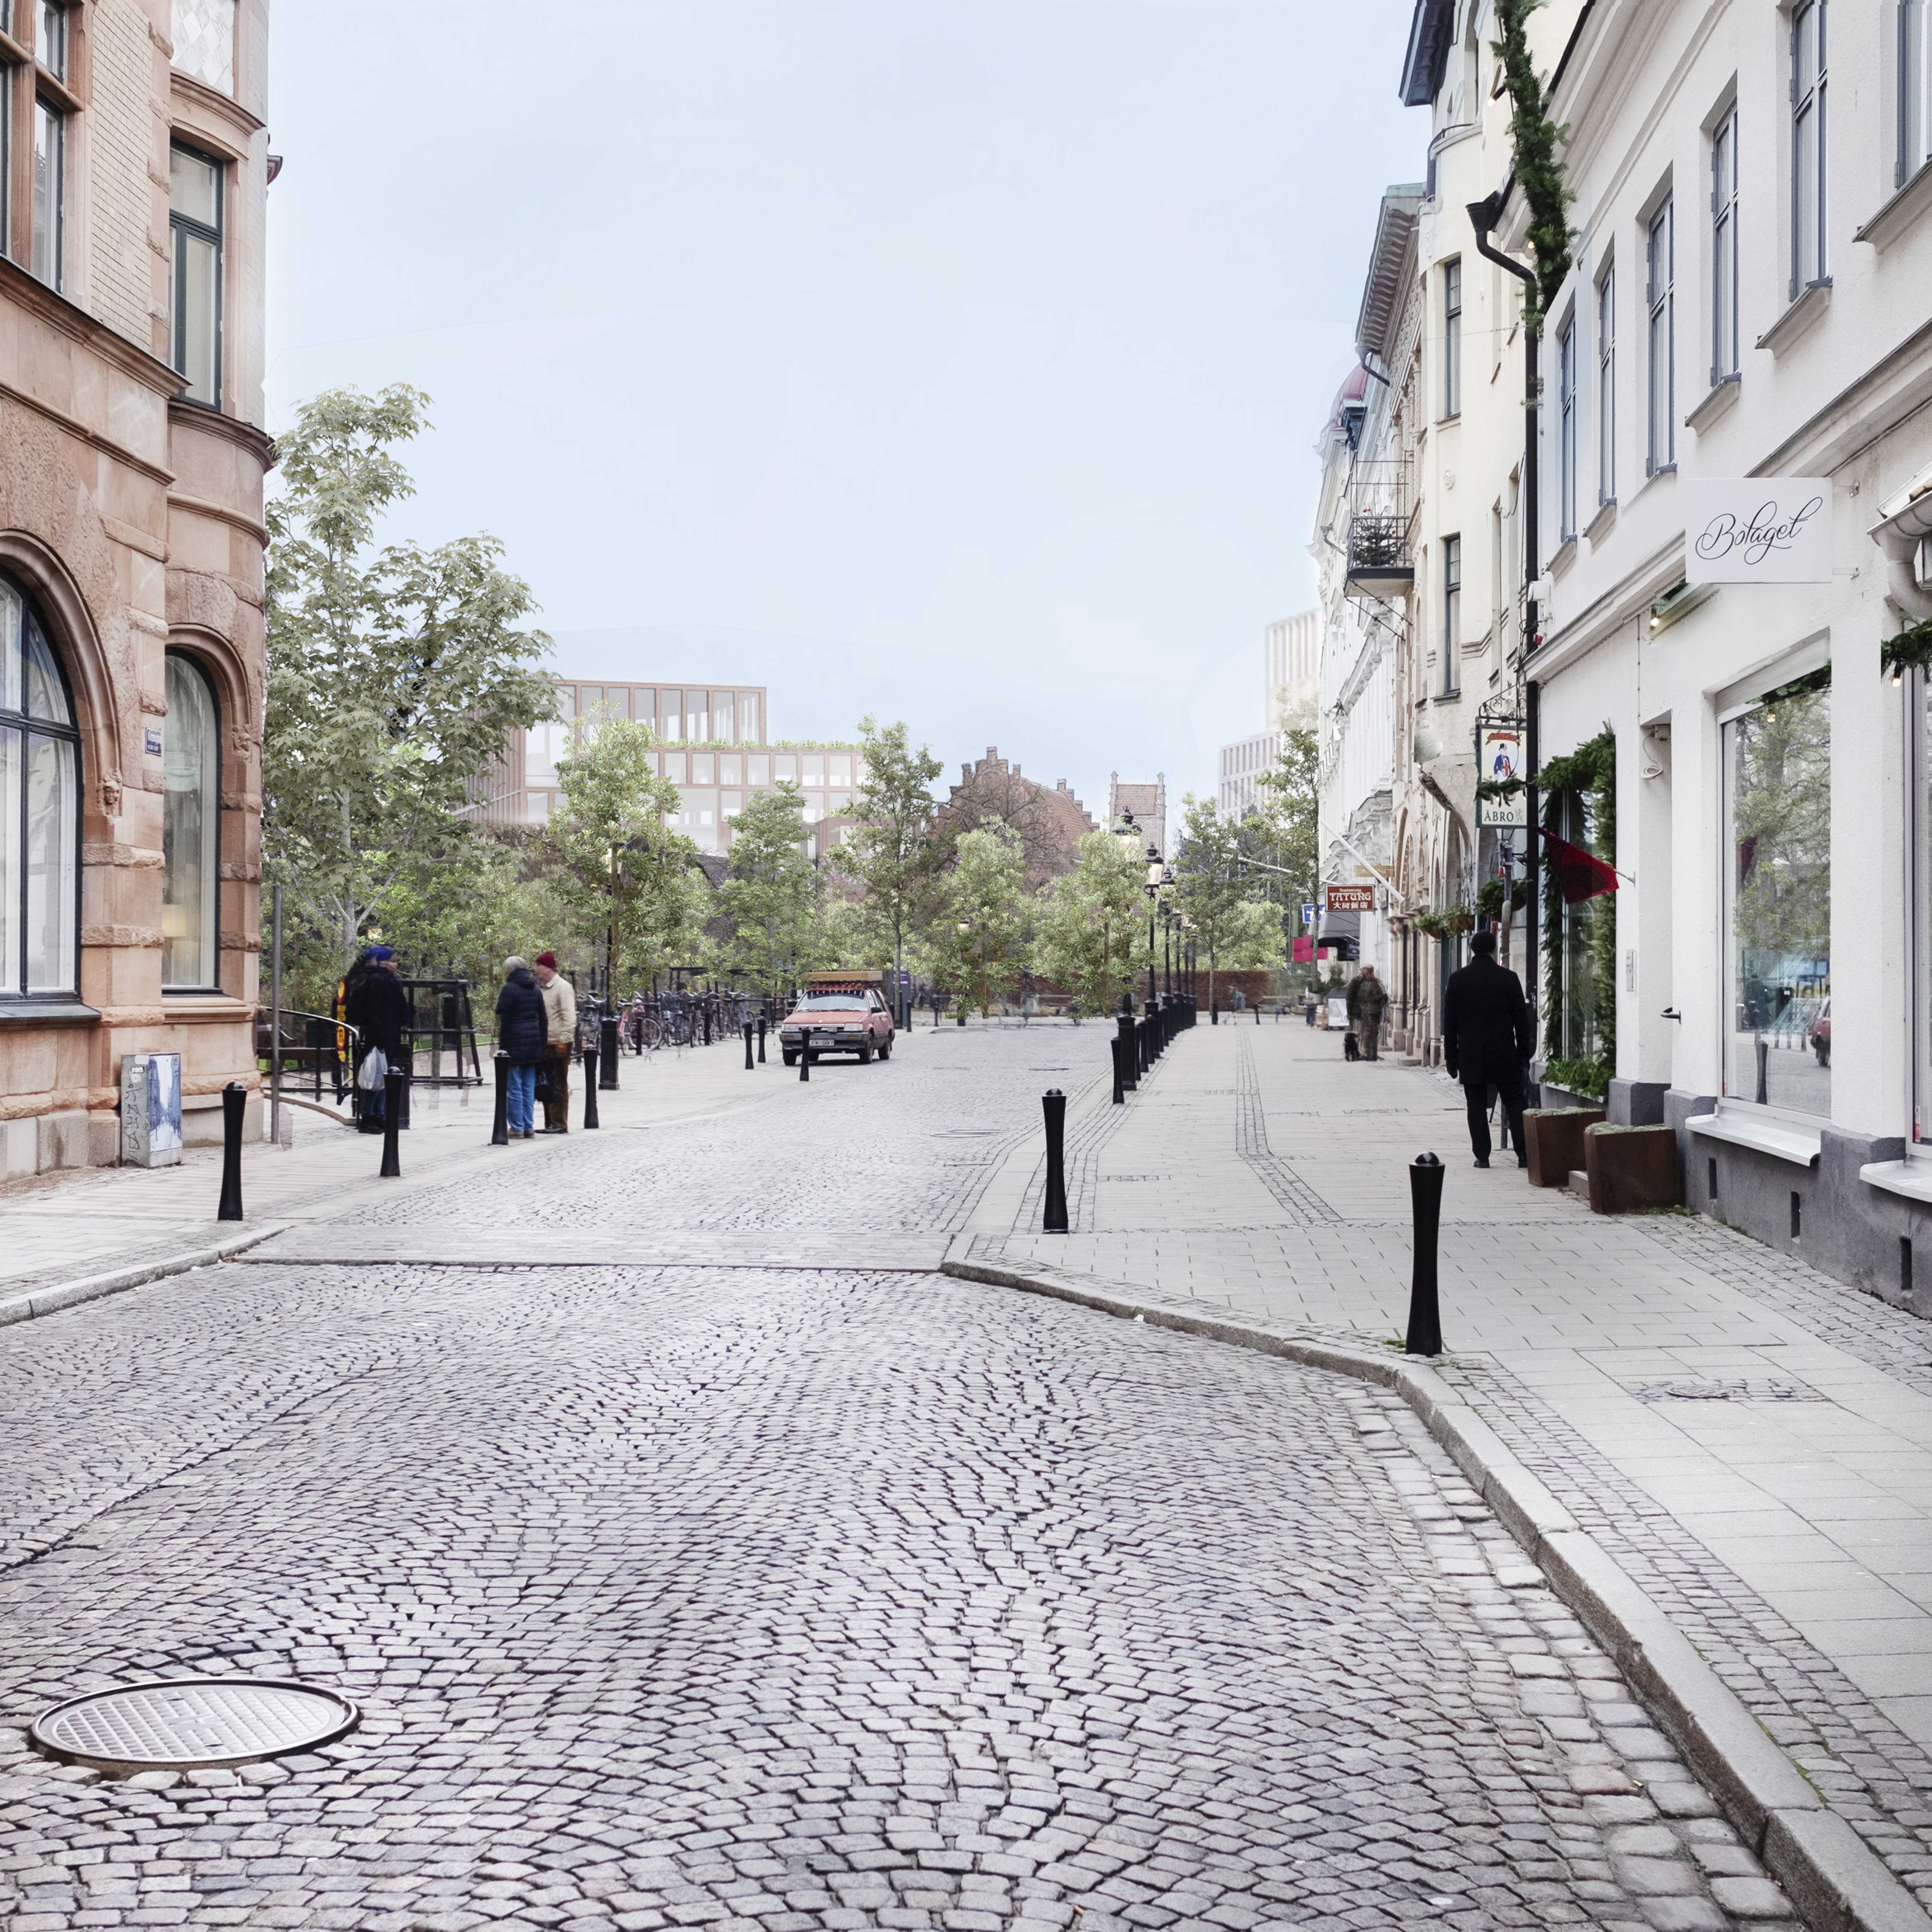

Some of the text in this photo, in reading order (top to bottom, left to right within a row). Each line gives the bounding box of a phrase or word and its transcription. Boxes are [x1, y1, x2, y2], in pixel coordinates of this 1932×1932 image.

[1695, 497, 1823, 565] Bolaget
[1484, 810, 1514, 822] ÅBRO
[1329, 892, 1372, 901] TATUNG
